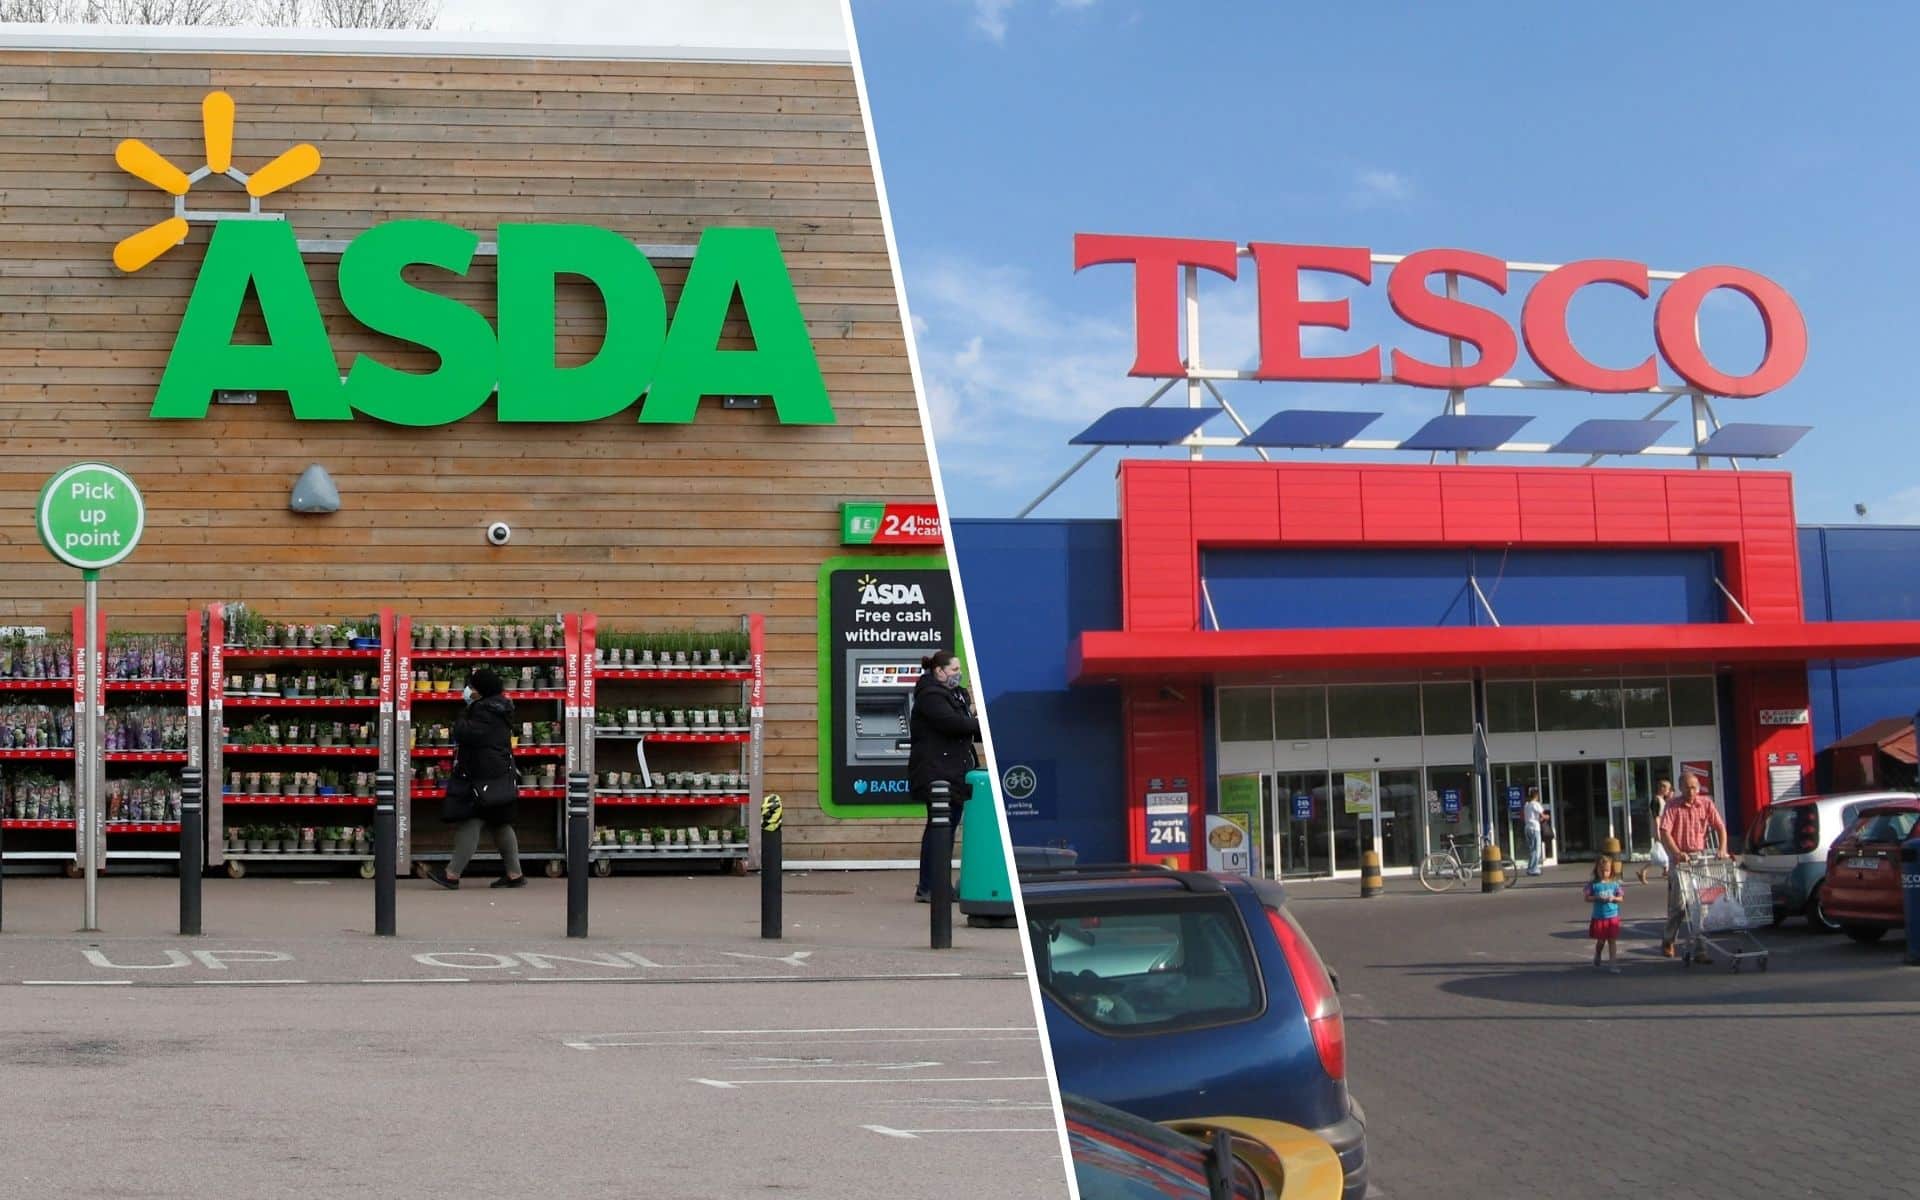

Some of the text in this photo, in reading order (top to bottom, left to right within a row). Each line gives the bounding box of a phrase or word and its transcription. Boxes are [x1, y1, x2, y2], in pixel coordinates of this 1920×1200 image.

[150, 219, 836, 426] ASDA
[1074, 233, 1808, 399] TESCO
[71, 482, 115, 500] Pick
[80, 509, 106, 526] up
[884, 515, 917, 536] 24
[65, 529, 120, 549] point
[861, 584, 925, 604] ASDA
[855, 608, 931, 622] Free cash
[845, 628, 941, 642] withdrawals
[399, 657, 408, 702] Multi Buy
[568, 654, 577, 698] Multi Buy
[583, 654, 592, 698] Multi Buy
[81, 950, 295, 969] UP
[411, 952, 812, 968] ONLY
